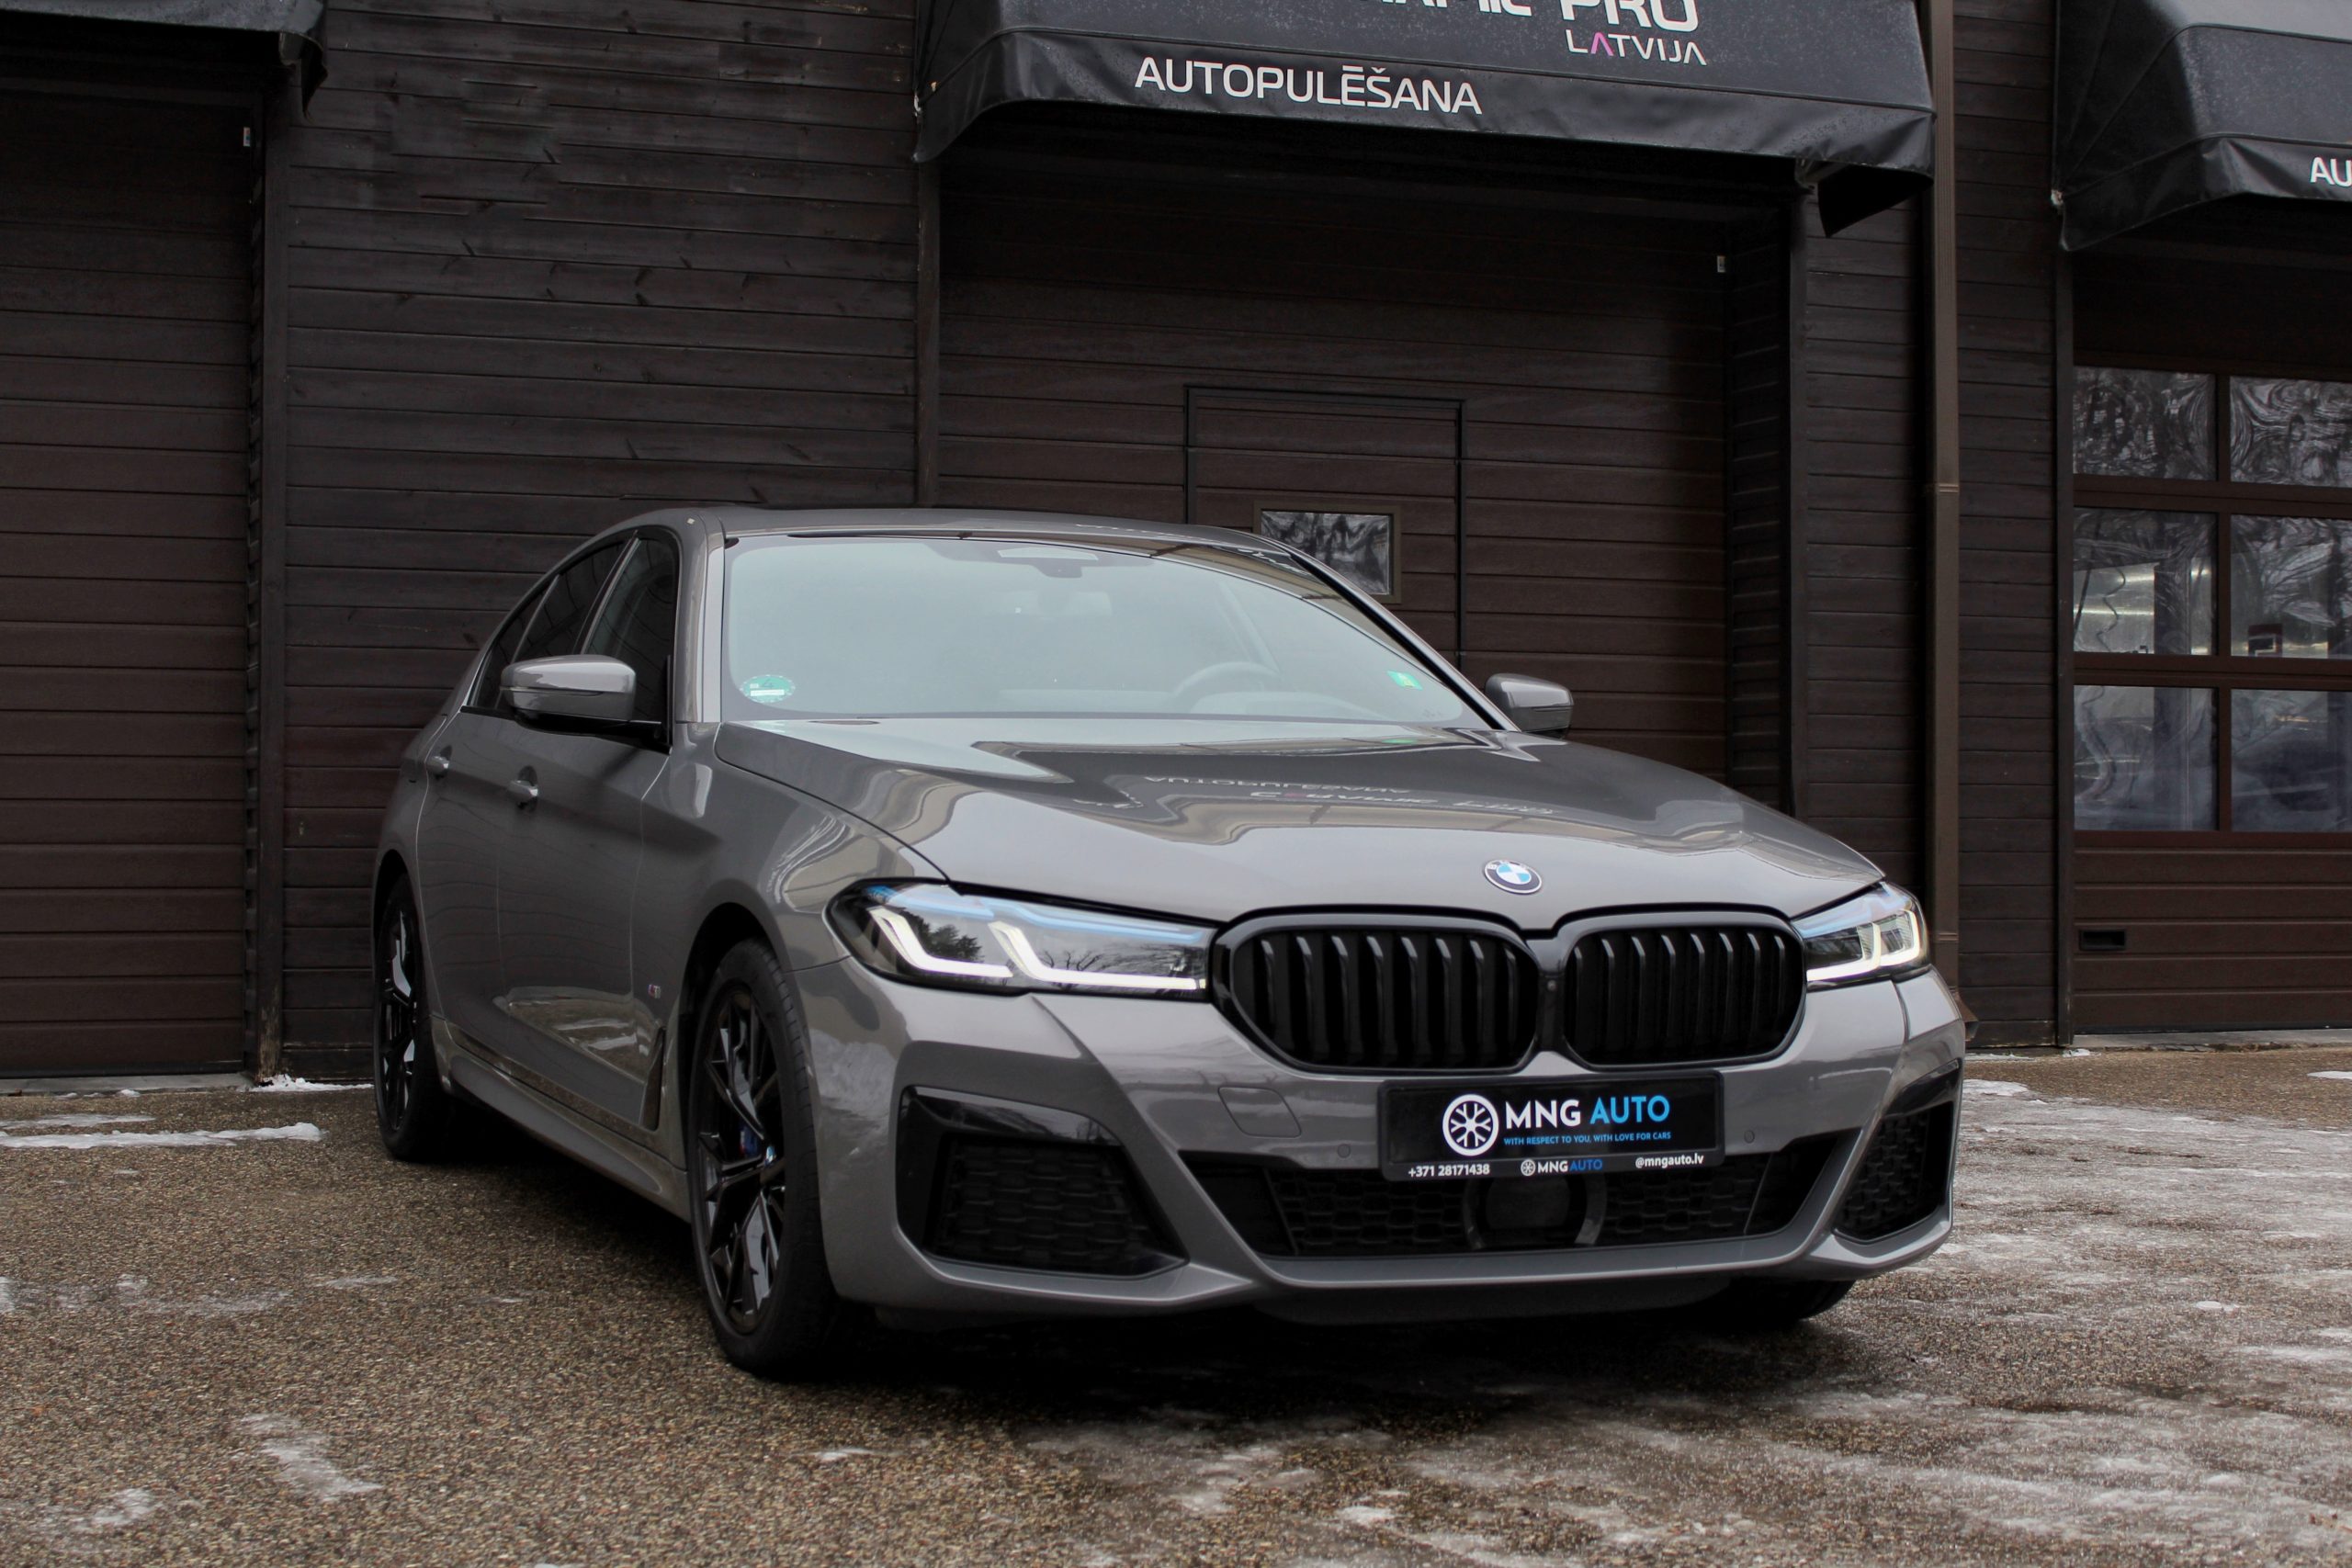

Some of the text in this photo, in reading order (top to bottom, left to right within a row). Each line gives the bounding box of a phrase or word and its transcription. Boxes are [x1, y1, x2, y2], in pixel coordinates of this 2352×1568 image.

[1566, 29, 1707, 65] LATVIJA
[1135, 57, 1483, 115] AUTOPULĒŠANA
[1506, 1095, 1670, 1130] MNG AUTO
[1504, 1137, 1524, 1145] WITH
[1526, 1136, 1559, 1145] RESPECT
[1562, 1135, 1572, 1144] TO
[1593, 1134, 1612, 1143] WITH
[1614, 1133, 1634, 1142] LOVE
[1636, 1132, 1651, 1141] FOR
[1652, 1131, 1671, 1140] CARS
[1408, 1164, 1490, 1178] +371 28171438
[1635, 1153, 1704, 1168] @mngauto.lv
